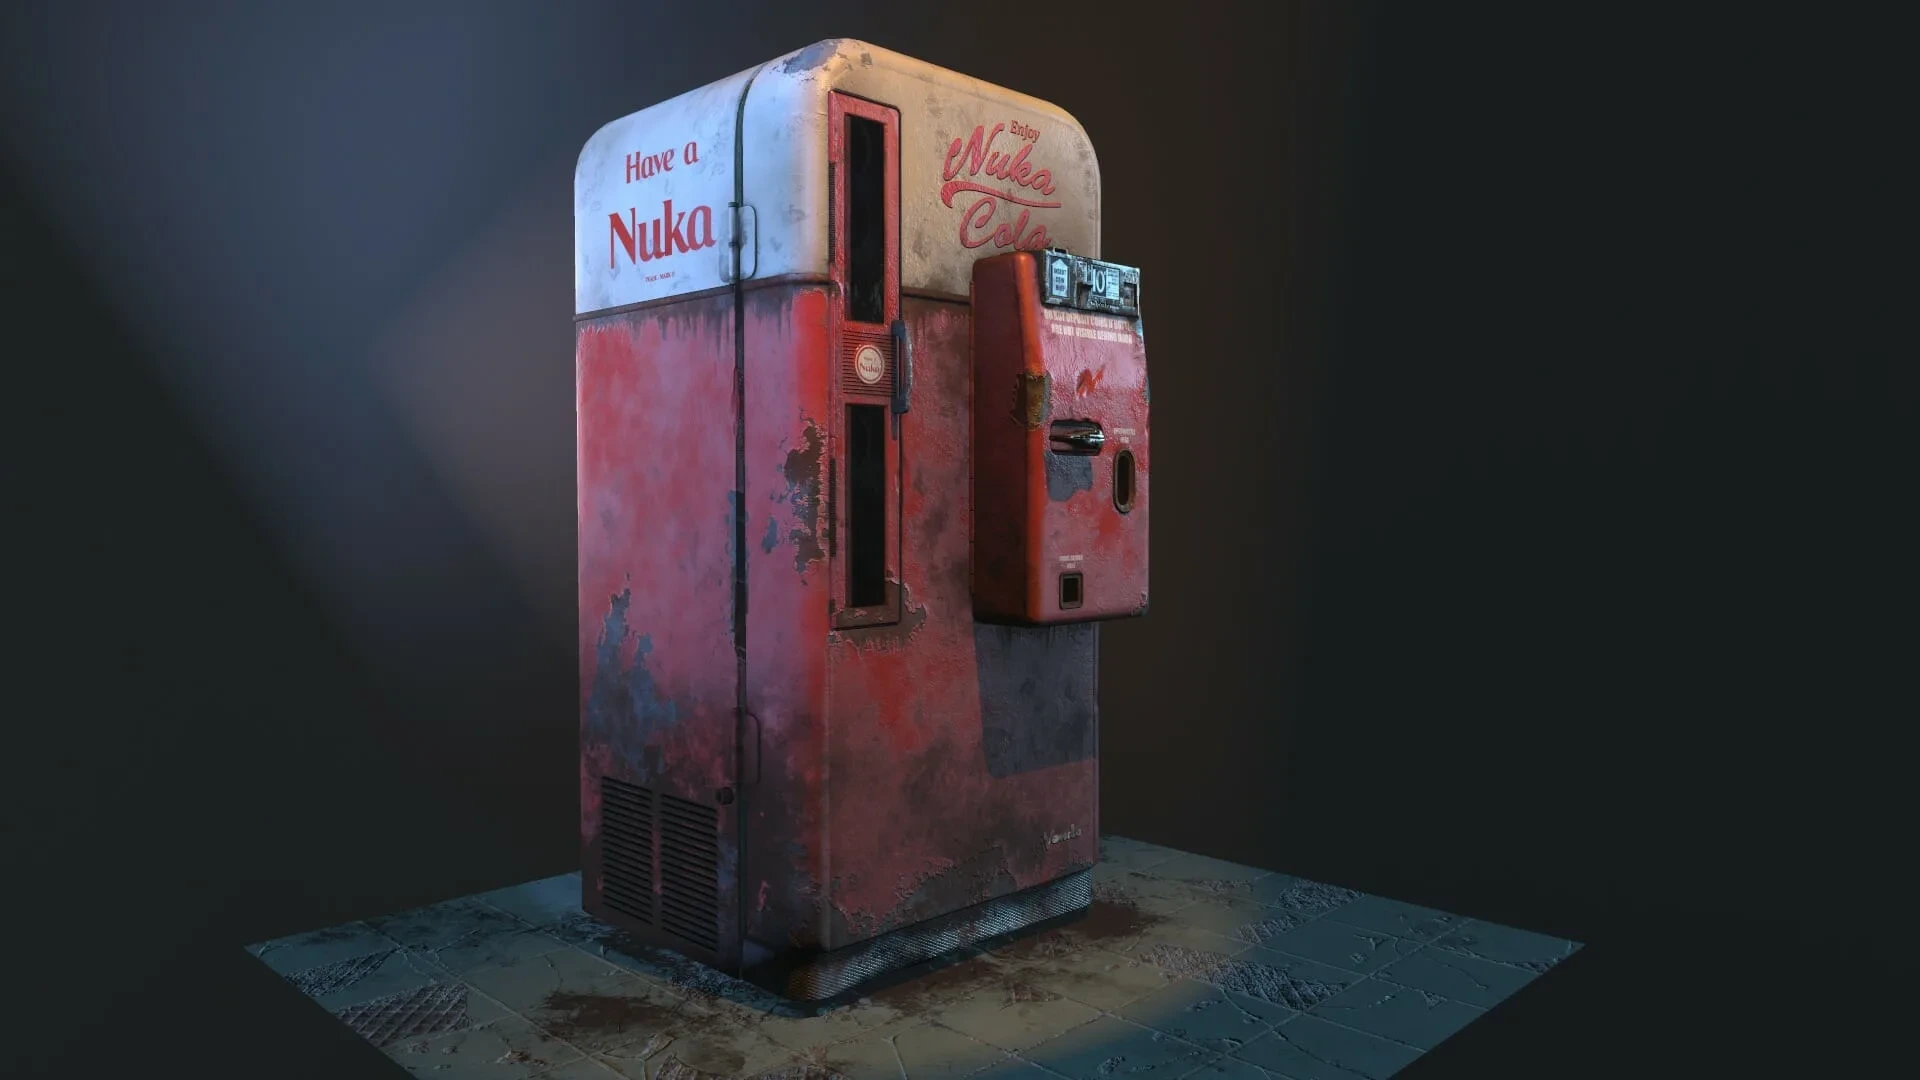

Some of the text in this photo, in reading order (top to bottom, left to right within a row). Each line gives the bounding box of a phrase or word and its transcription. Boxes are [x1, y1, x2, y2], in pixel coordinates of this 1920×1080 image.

[1010, 120, 1040, 143] Enjoy
[625, 141, 700, 184] Have a
[943, 123, 1056, 195] Nuka
[608, 199, 717, 270] Nuka
[960, 197, 1052, 251] Cola
